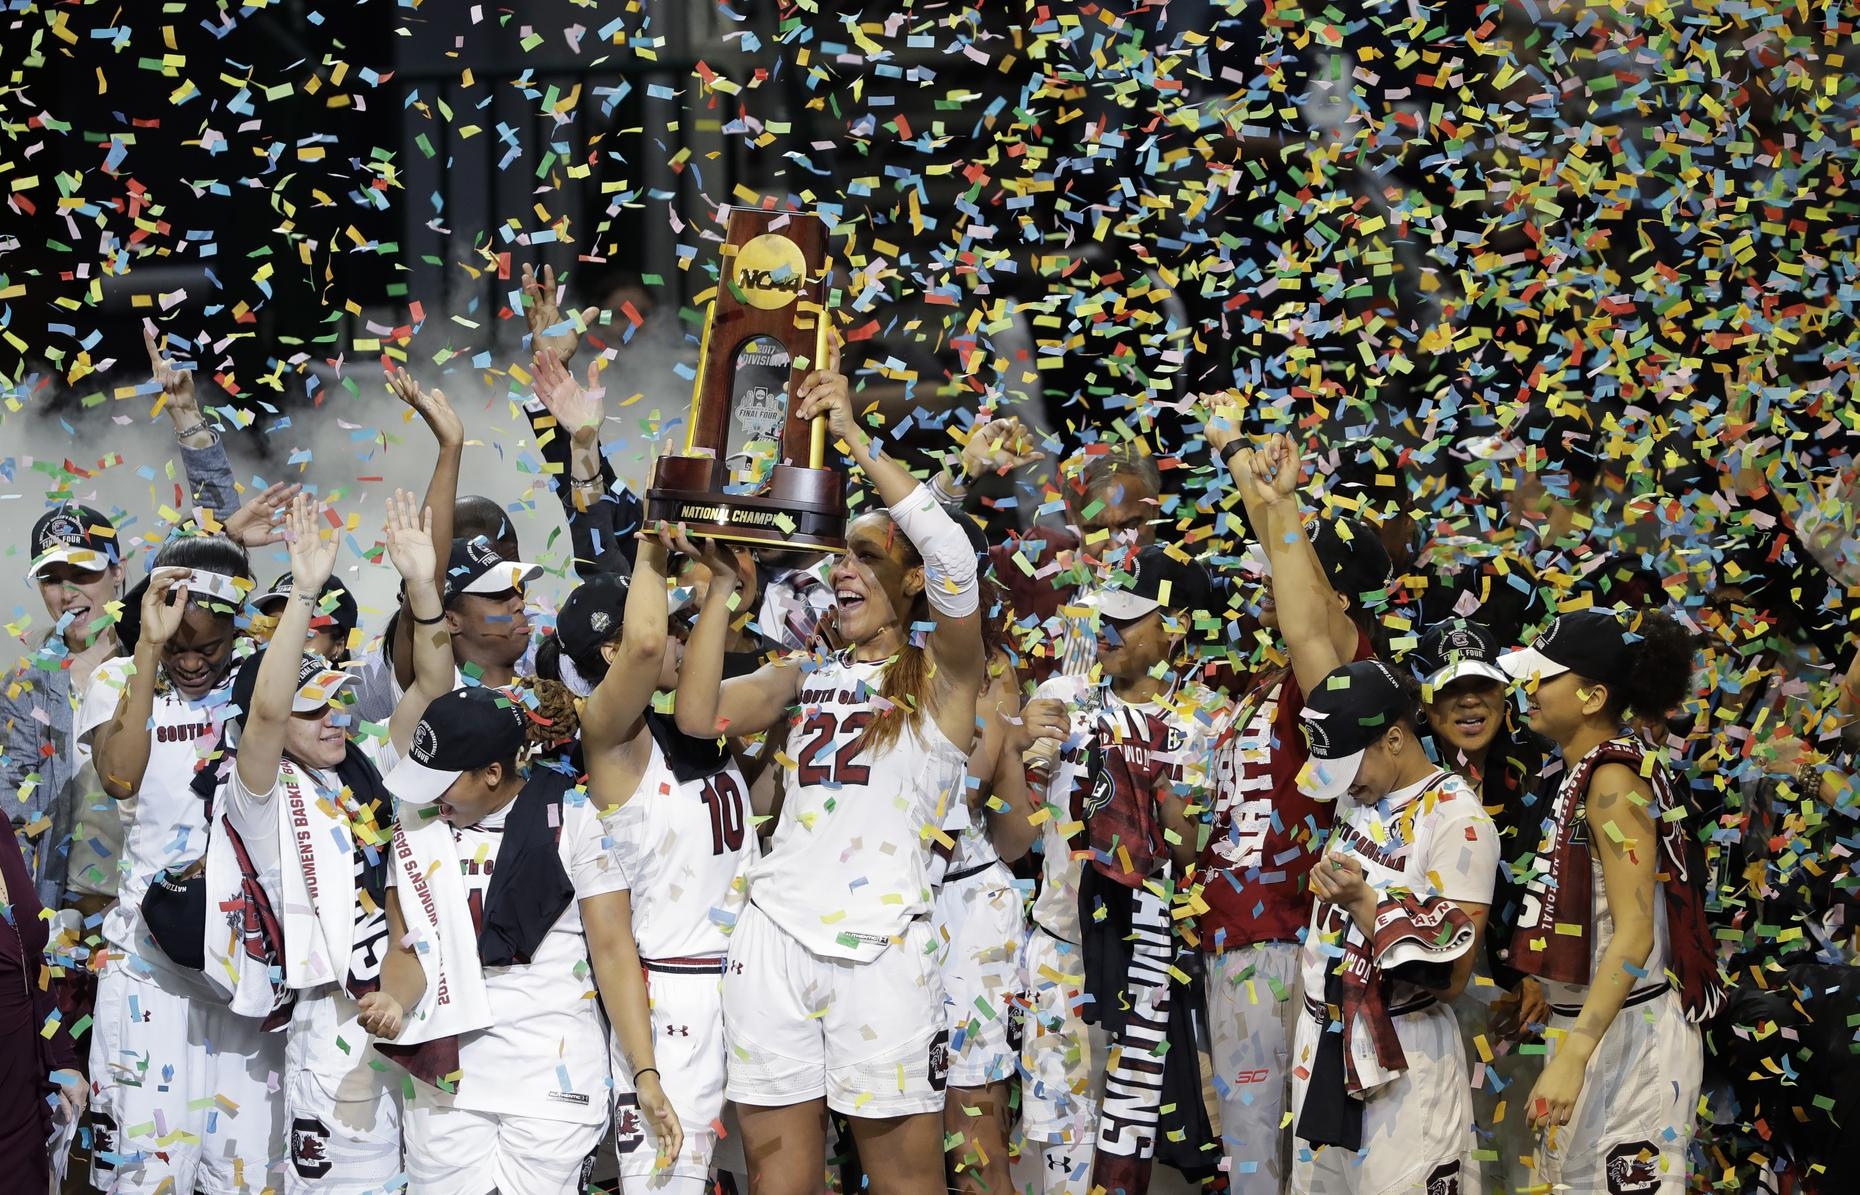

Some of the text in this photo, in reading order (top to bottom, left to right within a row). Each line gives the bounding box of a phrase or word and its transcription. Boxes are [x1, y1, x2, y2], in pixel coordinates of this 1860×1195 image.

[757, 344, 776, 355] 2017
[739, 409, 778, 420] FINAL FOUR
[681, 505, 793, 526] NATIONAL CHAMPI
[62, 535, 81, 544] FOUR
[1465, 649, 1484, 659] FOUR
[798, 712, 873, 787] 22
[280, 759, 319, 899] WOMEN'S BASKEBA
[700, 771, 745, 856] 10
[161, 879, 187, 893] NATION
[403, 860, 438, 928] WOMEN'S
[1542, 857, 1560, 930] NAIONAL
[1097, 866, 1172, 1159] AMPIONS
